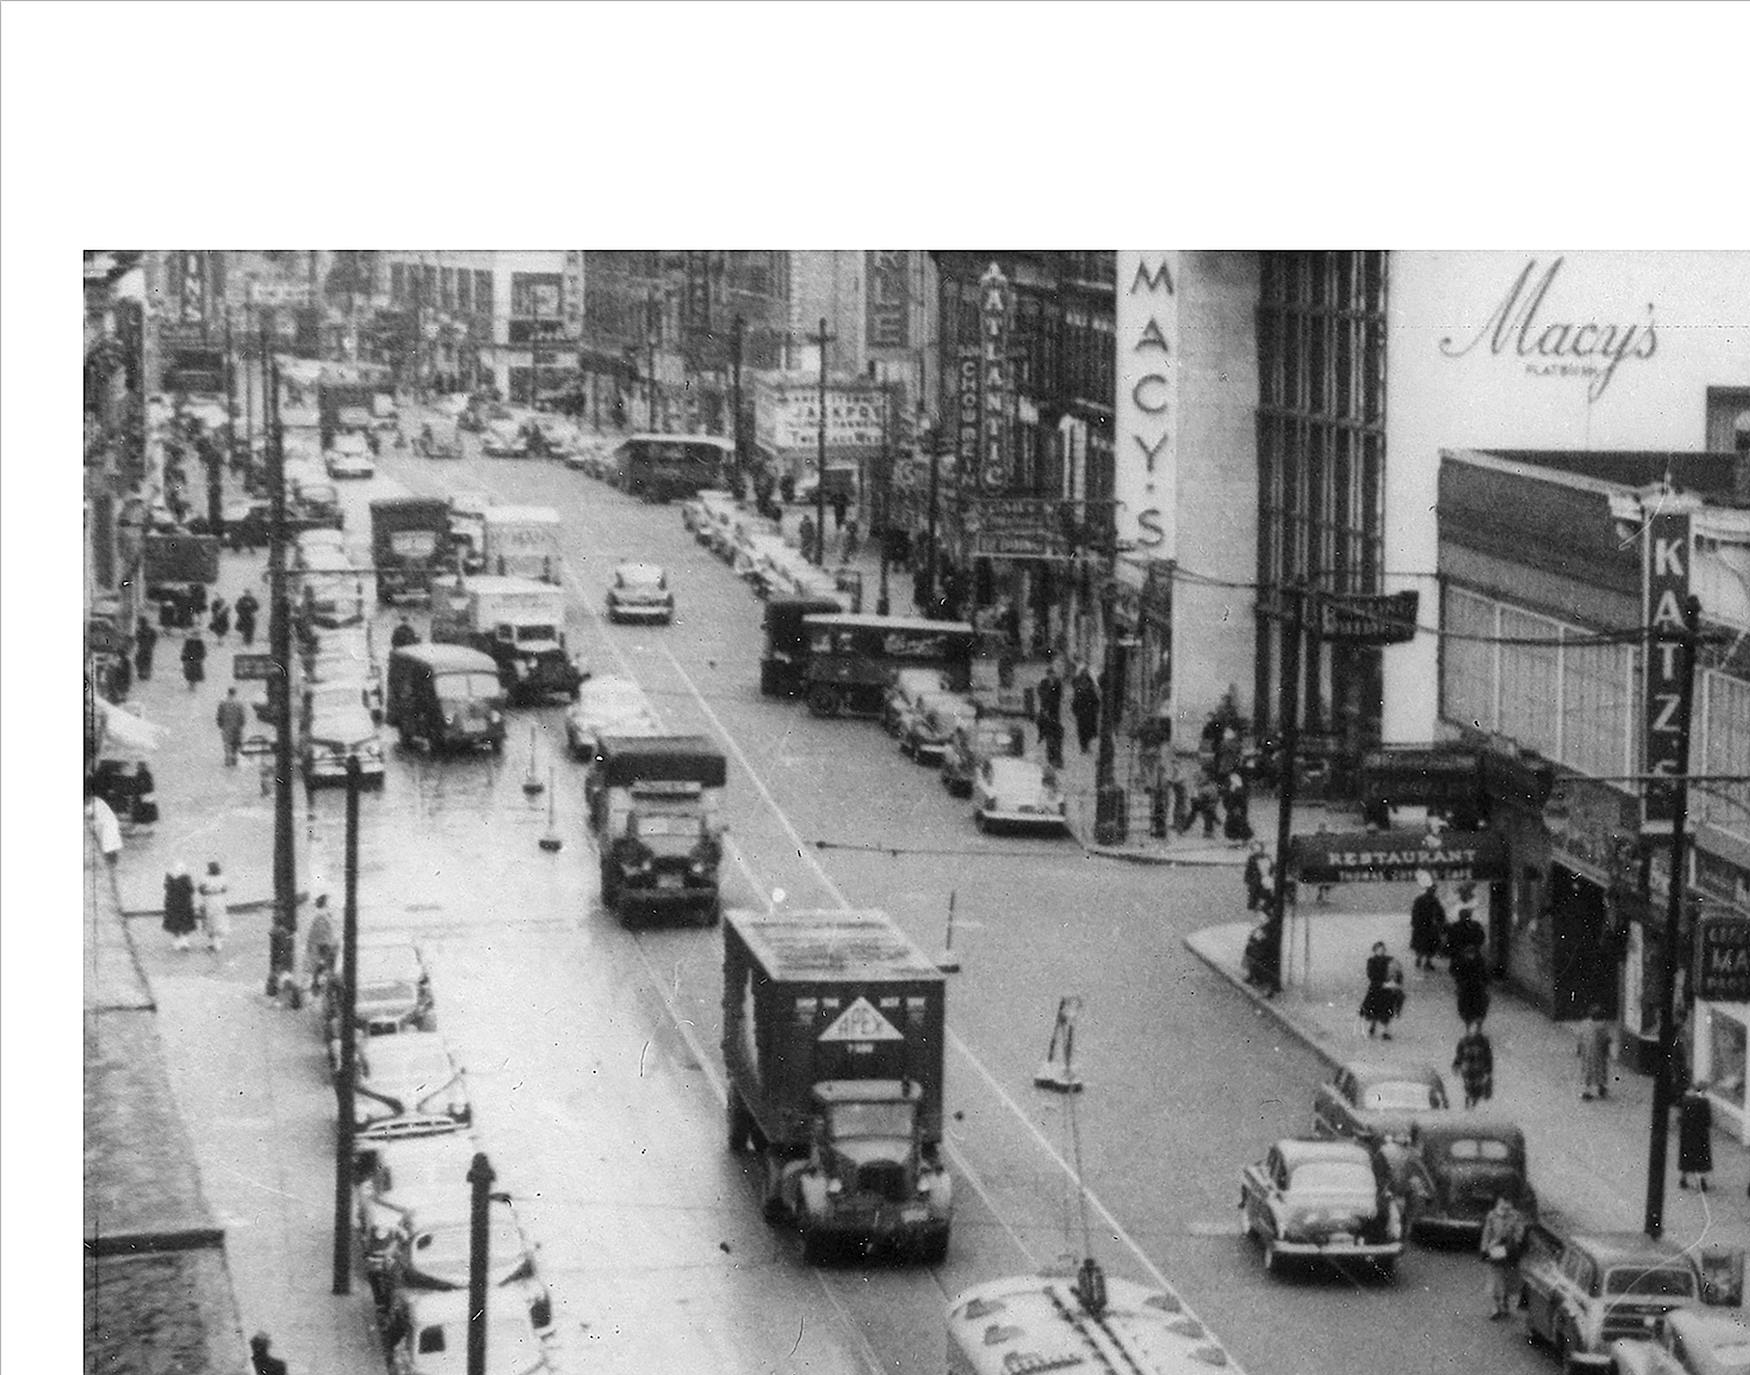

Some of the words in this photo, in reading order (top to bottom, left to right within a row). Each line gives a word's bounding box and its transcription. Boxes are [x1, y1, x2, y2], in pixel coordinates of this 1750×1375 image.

[1439, 257, 1657, 402] Macy's
[1131, 259, 1175, 548] MACY'S
[1329, 850, 1477, 866] RESTAURANT
